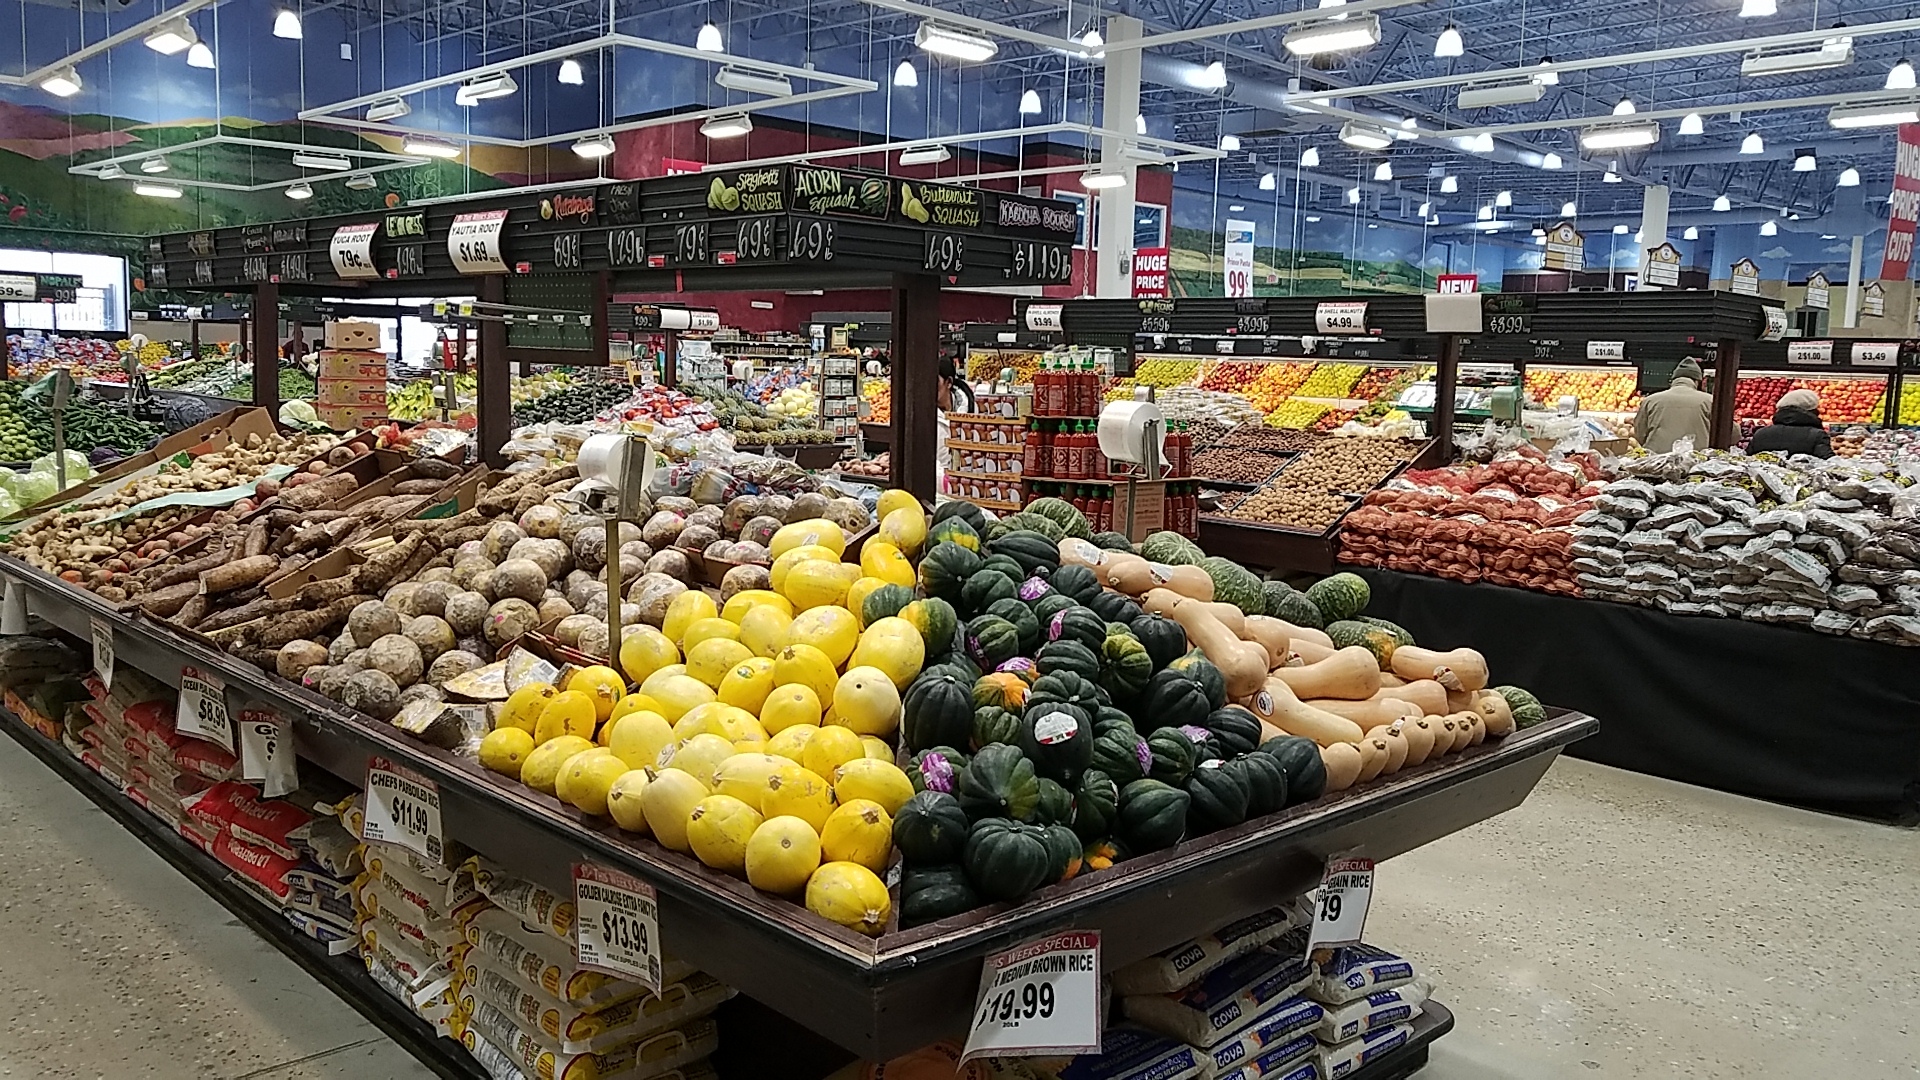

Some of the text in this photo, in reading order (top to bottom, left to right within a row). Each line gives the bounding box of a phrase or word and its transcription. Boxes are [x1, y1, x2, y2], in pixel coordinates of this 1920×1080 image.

[1896, 140, 1920, 180] HUG
[736, 169, 779, 192] Spaghetti
[795, 170, 841, 198] ACORN
[741, 192, 783, 212] SQUASH
[920, 185, 978, 205] Butternut
[1892, 188, 1919, 222] PRICE
[932, 206, 980, 228] SQUASH
[999, 199, 1077, 232] KABOCHA SQUASH
[333, 233, 371, 245] YUCA ROOT
[452, 222, 501, 236] YAUTIA ROOT
[459, 240, 489, 263] $1.69
[1887, 230, 1912, 262] CUTS
[339, 249, 363, 271] 79¢
[1135, 255, 1168, 272] HUGE
[1136, 275, 1165, 290] PRICE
[1439, 279, 1475, 294] NEW
[1033, 316, 1053, 327] $3.99
[1327, 317, 1352, 329] $4.99
[1862, 351, 1886, 361] $3.49
[198, 697, 226, 730] $8.99
[371, 773, 398, 790] CHEFS
[391, 795, 428, 835] $11.99
[1337, 860, 1370, 872] SPECIAL
[578, 884, 602, 901] GOLDEN
[1350, 875, 1370, 889] RICE
[602, 909, 649, 956] $13.99
[580, 943, 593, 951] TPR
[1044, 936, 1091, 953] SPECIAL
[1174, 947, 1204, 970] GOYA
[999, 954, 1094, 986] MEDIUM BROWN RICE
[1213, 1007, 1242, 1029] GOYA
[1216, 1046, 1244, 1068] GOYA
